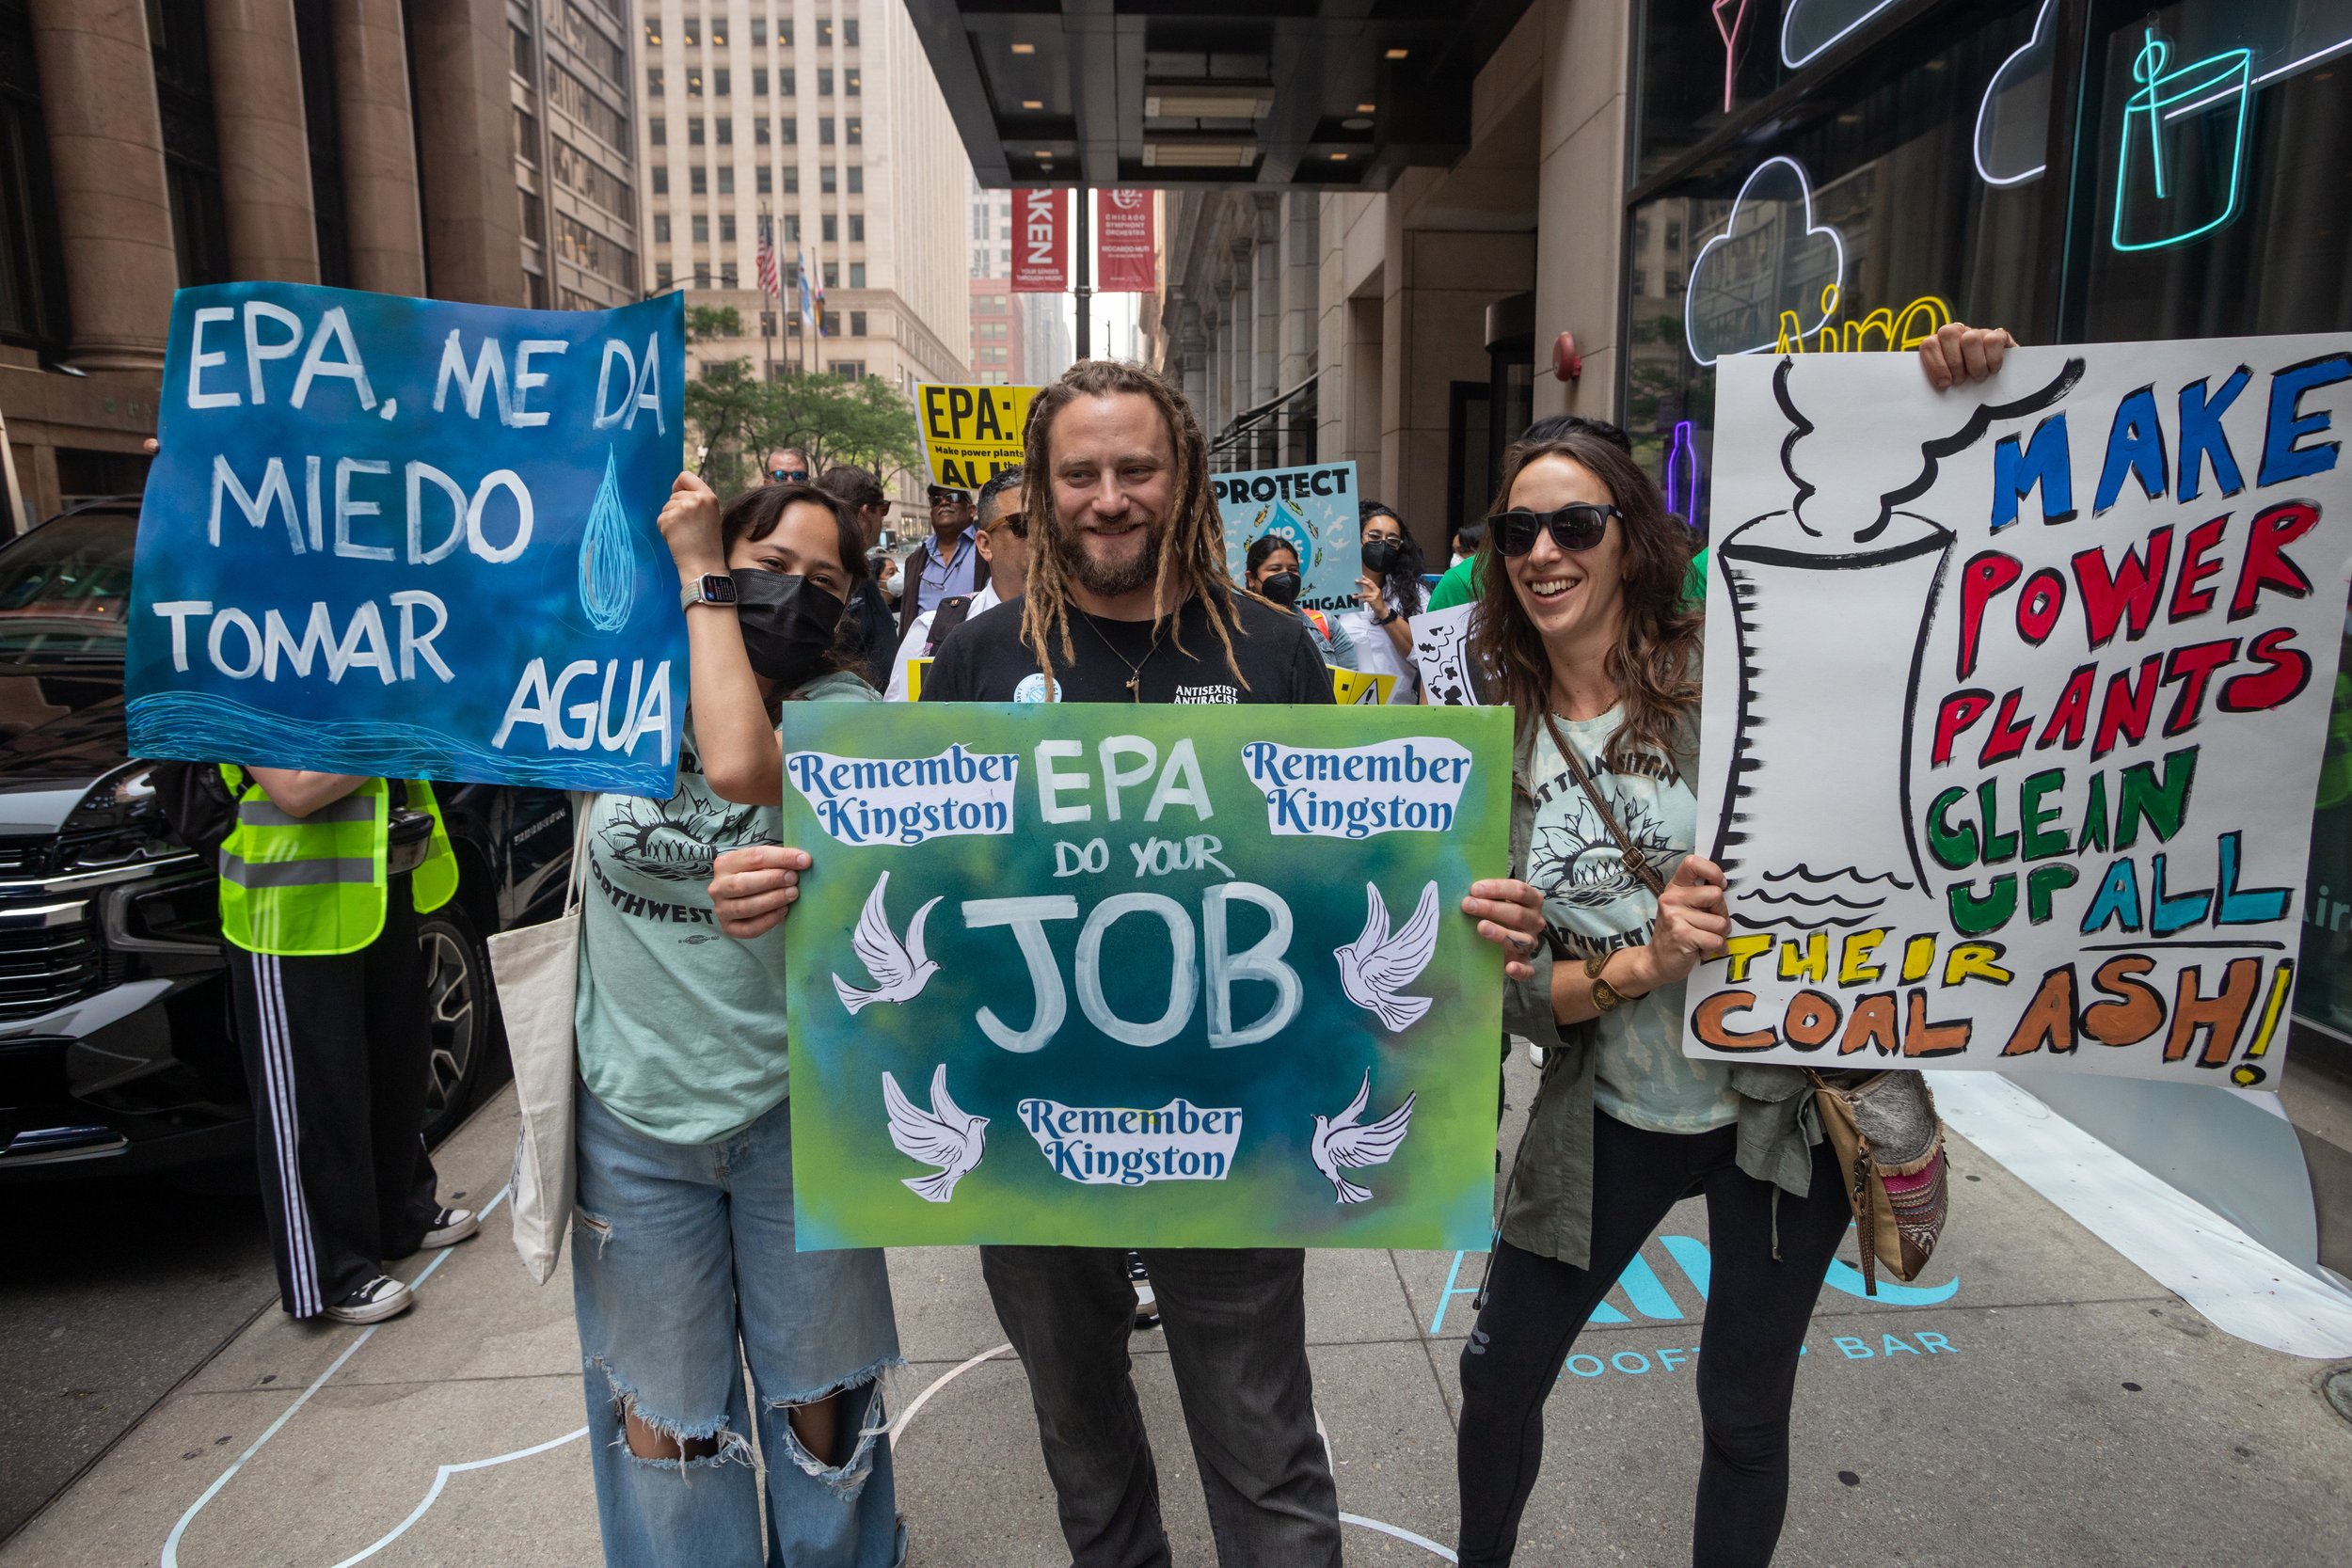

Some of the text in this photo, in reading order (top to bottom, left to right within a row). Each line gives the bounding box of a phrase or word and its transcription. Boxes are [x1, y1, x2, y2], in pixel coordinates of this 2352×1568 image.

[187, 300, 667, 436] EPA, ME DA
[925, 387, 1014, 441] EPA:
[935, 445, 1025, 458] Make power plants
[1989, 351, 2352, 536] MAKE
[207, 453, 535, 566] MIEDO
[1212, 467, 1350, 505] PROTECT
[1268, 525, 1295, 541] NO
[1956, 498, 2324, 685] POWER
[151, 589, 457, 686] TOMAR
[491, 657, 673, 768] AGUA
[1173, 694, 1239, 705] ANTIRACIST
[1175, 684, 1238, 697] ANTISEXIST
[1930, 626, 2313, 771] PLANTS
[787, 744, 1020, 794] Remember
[1034, 734, 1215, 825] EPA
[1243, 740, 1470, 787] Remember
[816, 792, 1008, 845] Kingston
[1265, 786, 1454, 838] Kingston
[1052, 833, 1237, 879] DO YOUR
[1947, 830, 2295, 939] UP ALL
[961, 880, 1305, 1054] JOB
[1700, 926, 2015, 988] THEIR
[1692, 986, 1974, 1059] COAL
[1020, 1099, 1243, 1138] Remember
[1042, 1136, 1227, 1187] Kingston
[1834, 1331, 1960, 1360] BAR
